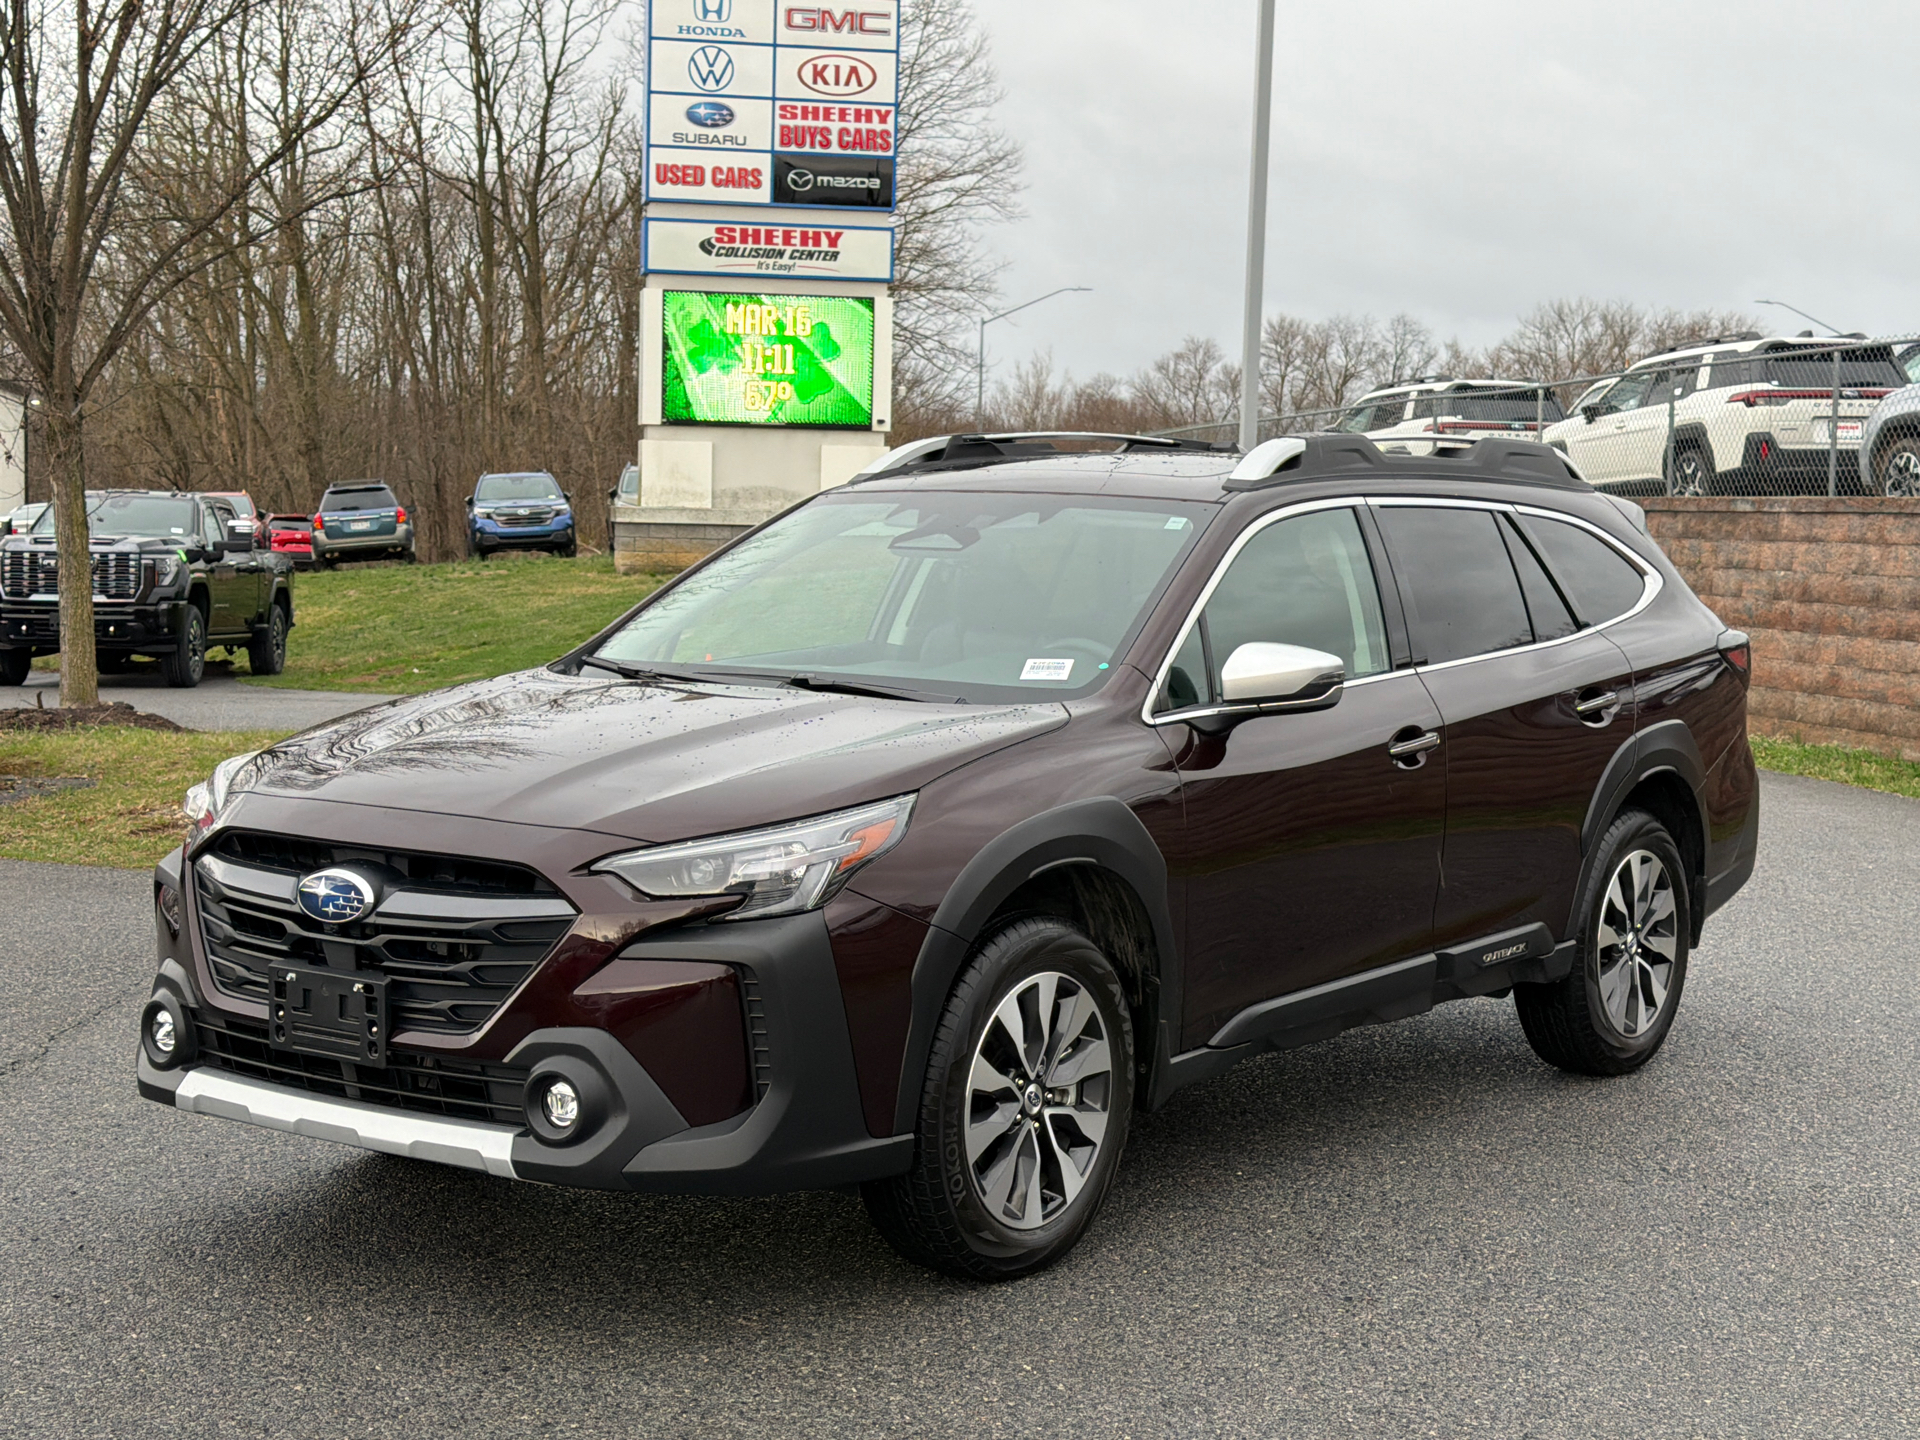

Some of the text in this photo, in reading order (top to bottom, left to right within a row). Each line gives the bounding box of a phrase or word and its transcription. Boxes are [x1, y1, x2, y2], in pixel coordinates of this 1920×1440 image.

[677, 25, 747, 38] HONDA
[785, 7, 891, 36] GMC
[811, 63, 864, 88] KIA
[778, 104, 893, 125] SHEEHY
[672, 132, 747, 147] SUBARU
[779, 124, 892, 152] BUYS CARS
[655, 163, 763, 190] USED CARS
[816, 175, 882, 190] mazda
[714, 226, 844, 249] SHEEHY
[714, 245, 842, 262] COLLISION CENTER
[756, 261, 797, 273] It's Easy!
[726, 303, 813, 337] MAR 16
[740, 342, 796, 375] 11:11
[1482, 942, 1527, 962] OUTBACK
